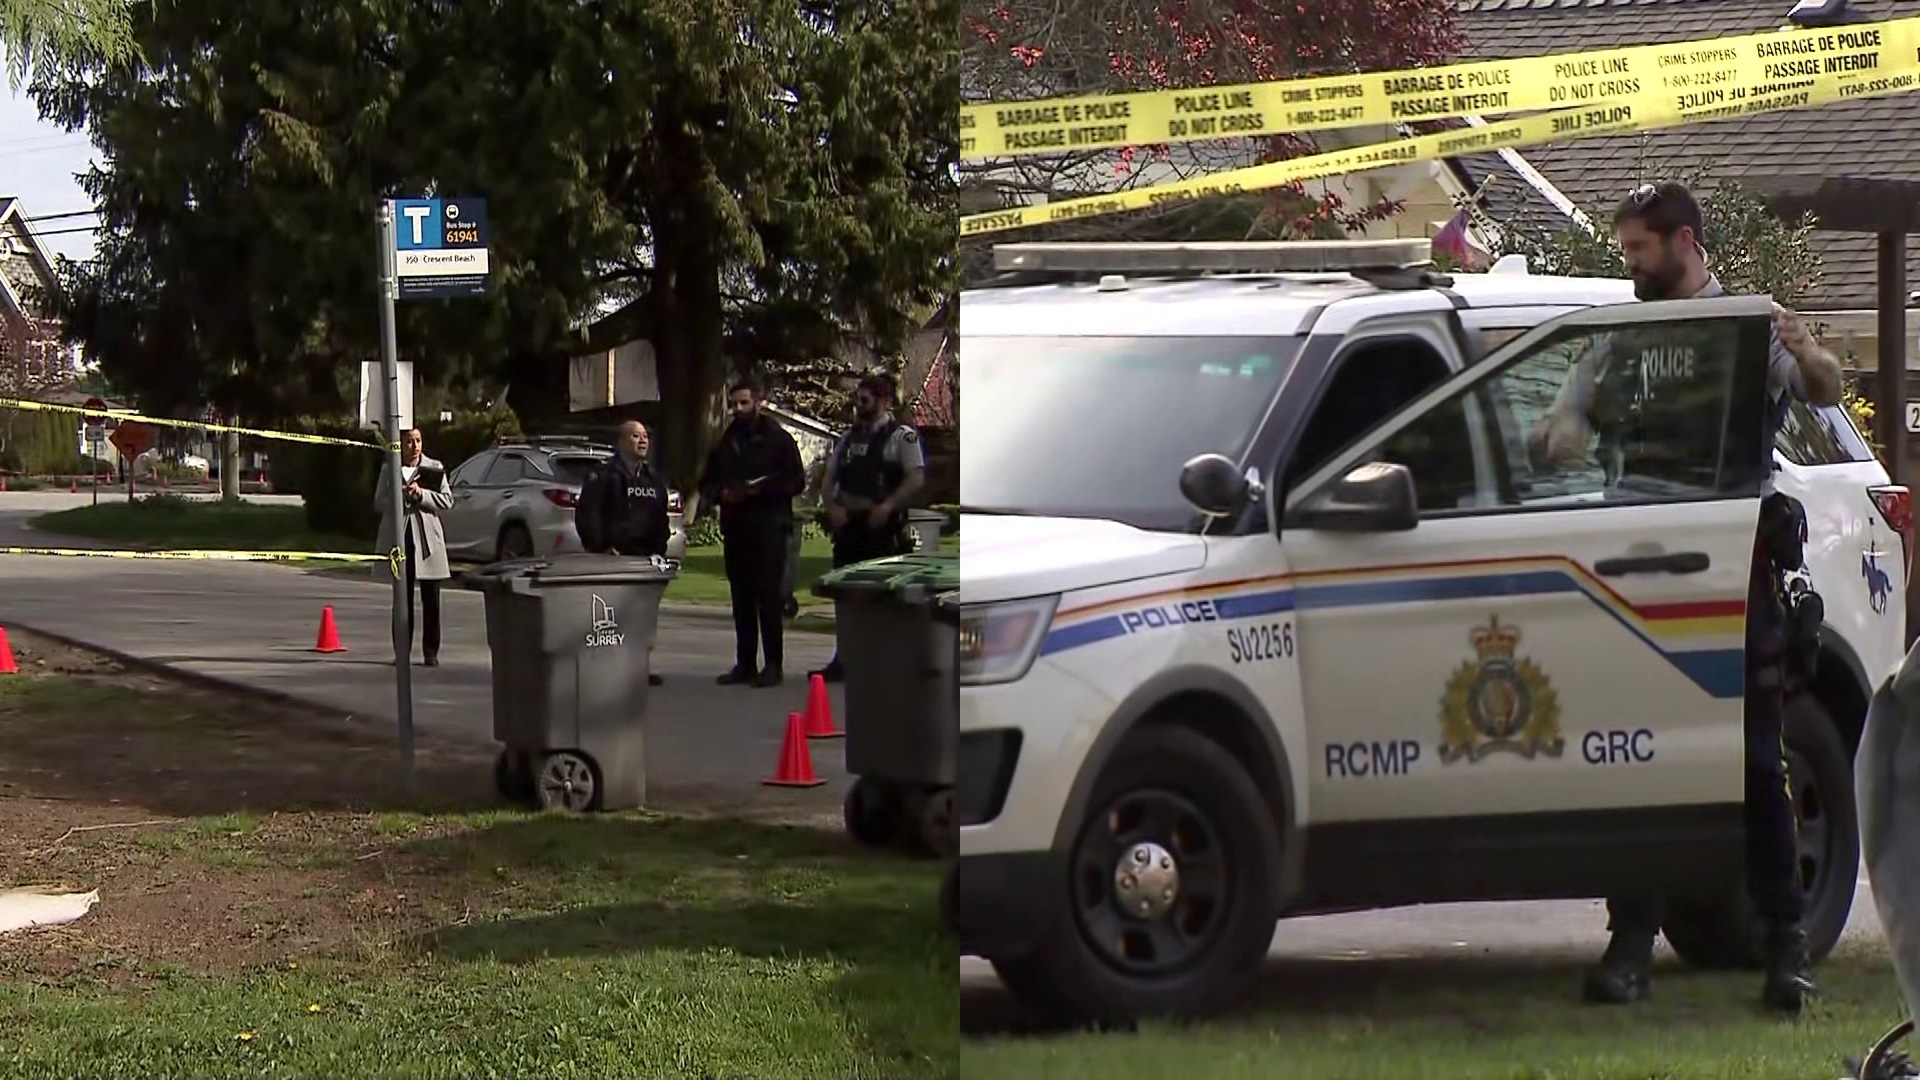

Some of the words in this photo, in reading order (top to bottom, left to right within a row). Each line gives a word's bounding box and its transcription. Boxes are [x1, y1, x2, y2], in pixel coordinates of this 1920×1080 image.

[1757, 37, 1815, 58] BARRAGE
[1818, 35, 1835, 51] DE
[1837, 30, 1881, 50] POLICE
[1554, 60, 1598, 79] POLICE
[1602, 57, 1630, 74] LINE
[1657, 52, 1687, 68] CRIME
[1690, 48, 1737, 66] STOPPERS
[1764, 59, 1820, 79] PASSAGE
[1824, 52, 1879, 73] INTERDIT
[1383, 76, 1447, 96] BARRAGE
[1447, 74, 1465, 89] DE
[1468, 69, 1511, 87] POLICE
[1549, 86, 1566, 102] DO
[1571, 83, 1596, 100] NOT
[1600, 78, 1640, 96] CROSS
[1662, 69, 1737, 88] 1-800-222-8477
[1174, 94, 1220, 113] POLICE
[1225, 91, 1253, 109] LINE
[1282, 89, 1313, 103] CRIME
[1315, 85, 1363, 101] STOPPERS
[1391, 97, 1450, 117] PASSAGE
[1452, 92, 1509, 112] INTERDIT
[996, 107, 1059, 127] BARRAGE
[1063, 105, 1081, 122] DE
[1084, 102, 1131, 120] POLICE
[1169, 120, 1187, 137] DO
[1191, 117, 1216, 134] NOT
[1220, 114, 1263, 131] CROSS
[1004, 129, 1065, 149] PASSAGE
[1069, 124, 1127, 144] INTERDIT
[403, 207, 431, 244] T
[446, 231, 478, 243] 61941
[454, 254, 476, 263] Beach
[1640, 346, 1694, 378] POLICE
[1911, 407, 1920, 428] 2
[1124, 600, 1217, 634] POLICE
[585, 633, 625, 646] SURREY
[1227, 622, 1294, 664] SU2256
[1324, 740, 1420, 778] RCMP
[1582, 729, 1655, 764] GRC
